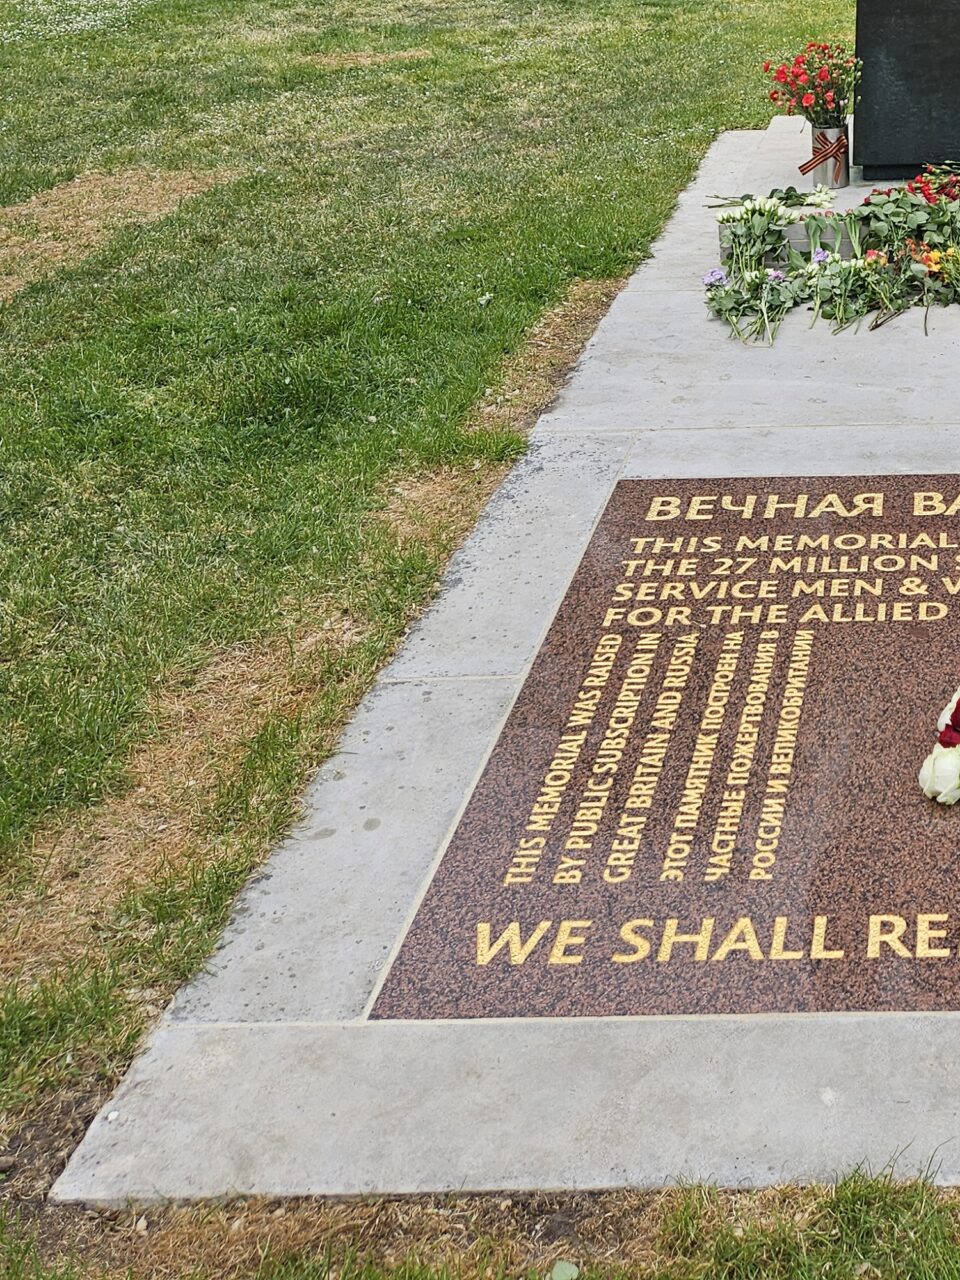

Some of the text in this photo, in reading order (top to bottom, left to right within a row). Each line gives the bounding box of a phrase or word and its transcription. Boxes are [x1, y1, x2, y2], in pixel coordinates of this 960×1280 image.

[621, 558, 700, 577] THE
[710, 557, 759, 575] 27
[768, 554, 939, 574] MILLION
[629, 535, 723, 554] THIS
[734, 532, 959, 552] MEMORIAL
[645, 492, 885, 521] ВЕЧНАЯ
[601, 606, 692, 627] FOR
[704, 604, 789, 625] THE
[798, 601, 949, 623] ALLIED
[611, 580, 779, 602] SERVICE
[791, 578, 883, 598] MEN
[898, 576, 930, 596] &
[503, 634, 622, 886] THIS MEMORIAL WAS RAISED
[552, 633, 662, 884] BY PUBLIC SUBSCRIPTION IN
[603, 631, 700, 883] GREAT BRITAIN AND RUSSIA
[659, 630, 744, 881] ЭТОТ ПАМЯТНИК ПОСТРОЕН НА
[704, 629, 779, 881] ЧАСТНЫЕ ПОЖЕРТВОВАНИЯ В
[749, 630, 815, 880] РОССИИ И ВЕЛИКОБРИТАНИИ
[475, 918, 595, 966] WE
[611, 915, 845, 964] SHALL
